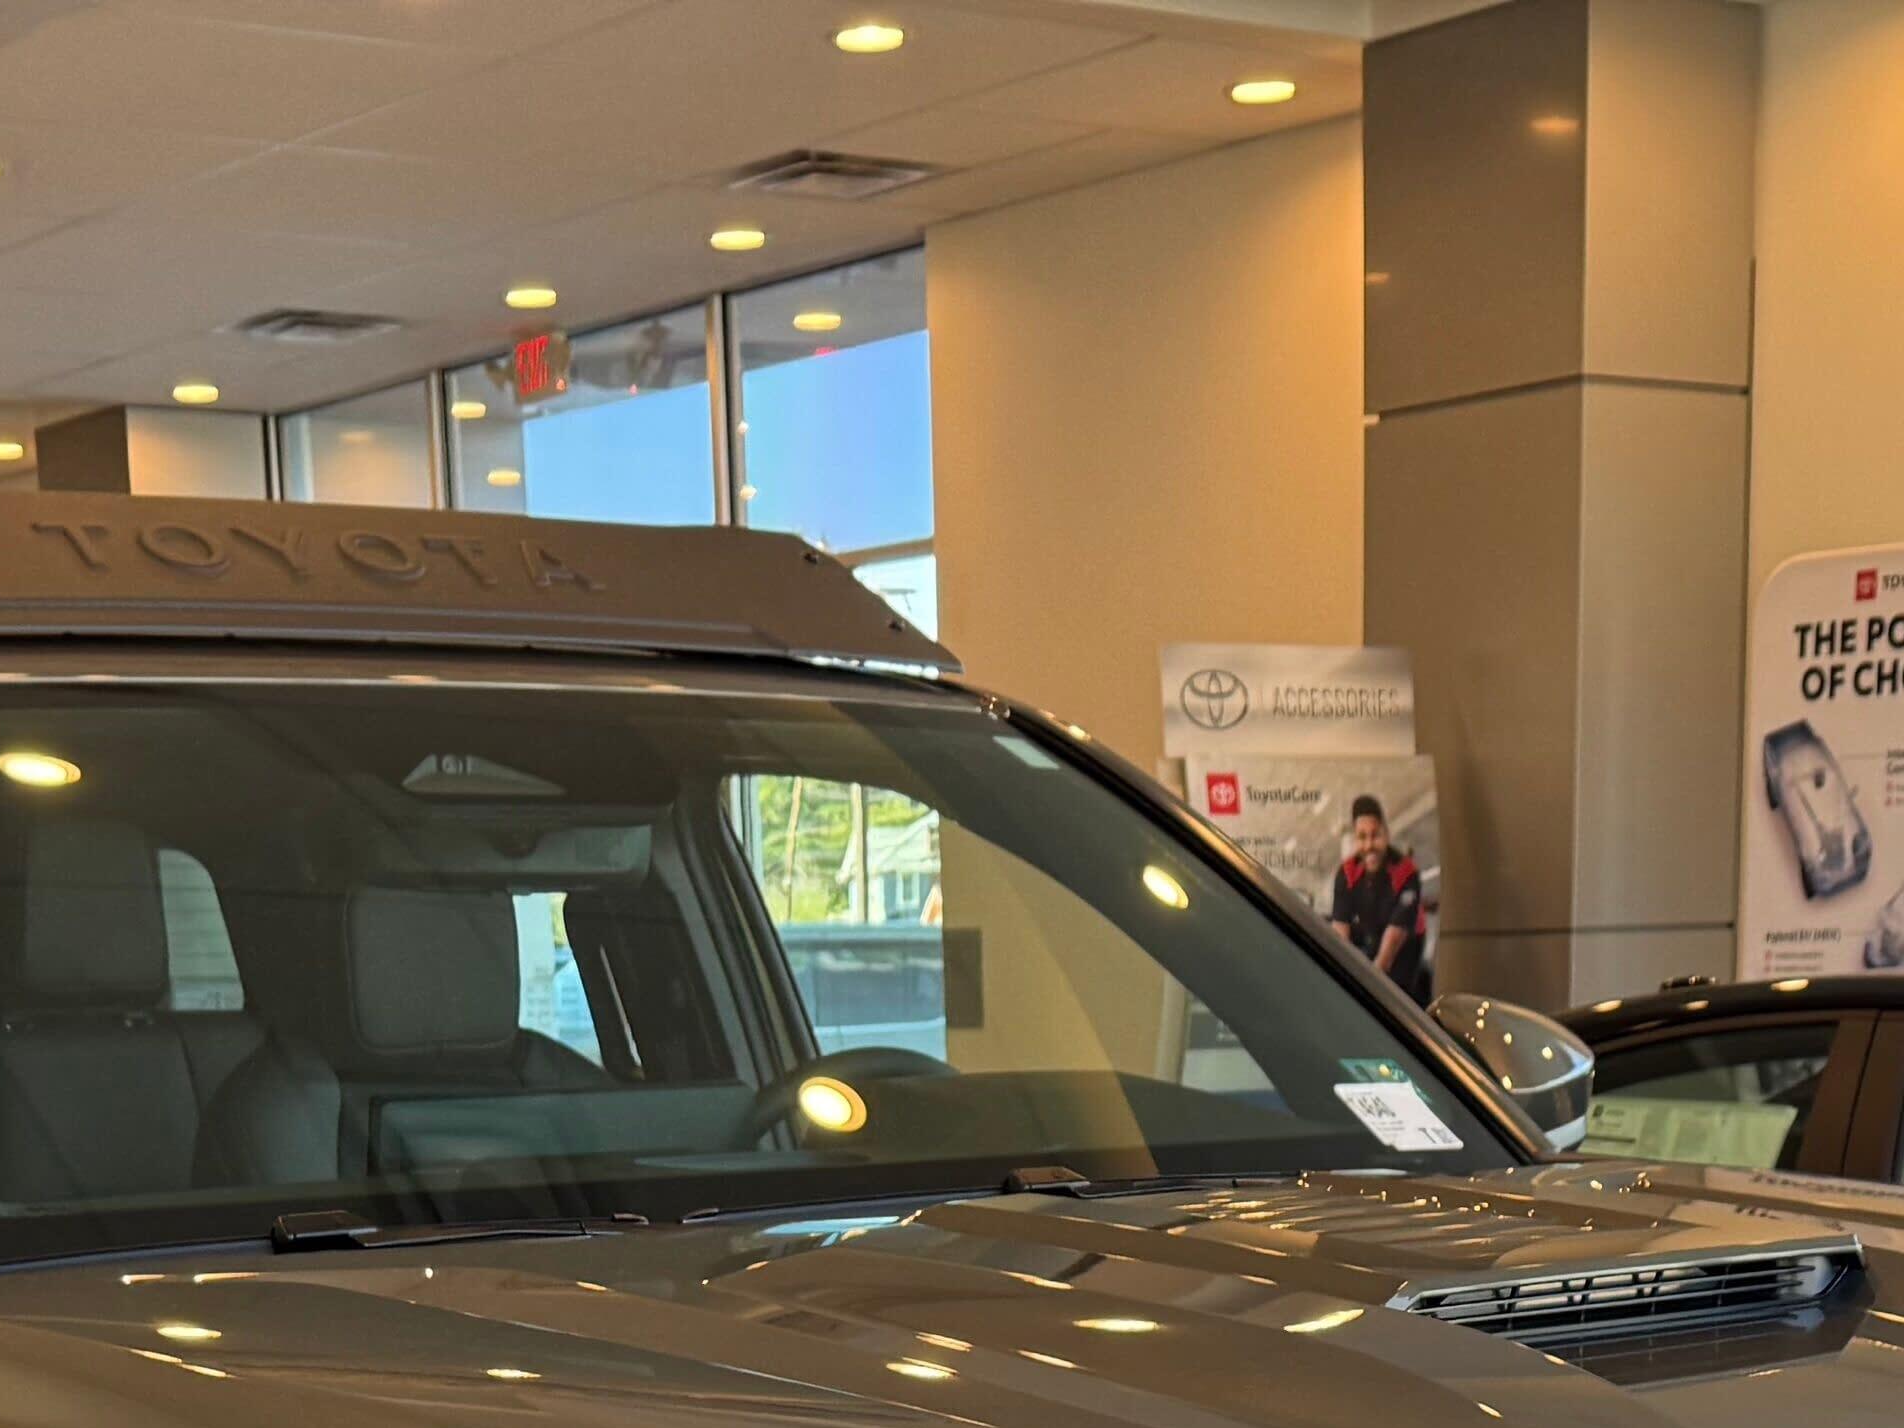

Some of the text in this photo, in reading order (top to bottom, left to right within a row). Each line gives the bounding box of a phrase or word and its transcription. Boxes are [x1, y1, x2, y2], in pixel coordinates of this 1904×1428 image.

[516, 335, 549, 394] EXIT
[30, 520, 609, 595] TOYOTA
[1794, 618, 1857, 658] THE
[1802, 666, 1845, 701] OF
[1272, 685, 1400, 721] ACCESSORIES
[1246, 785, 1322, 806] ToyotaCare
